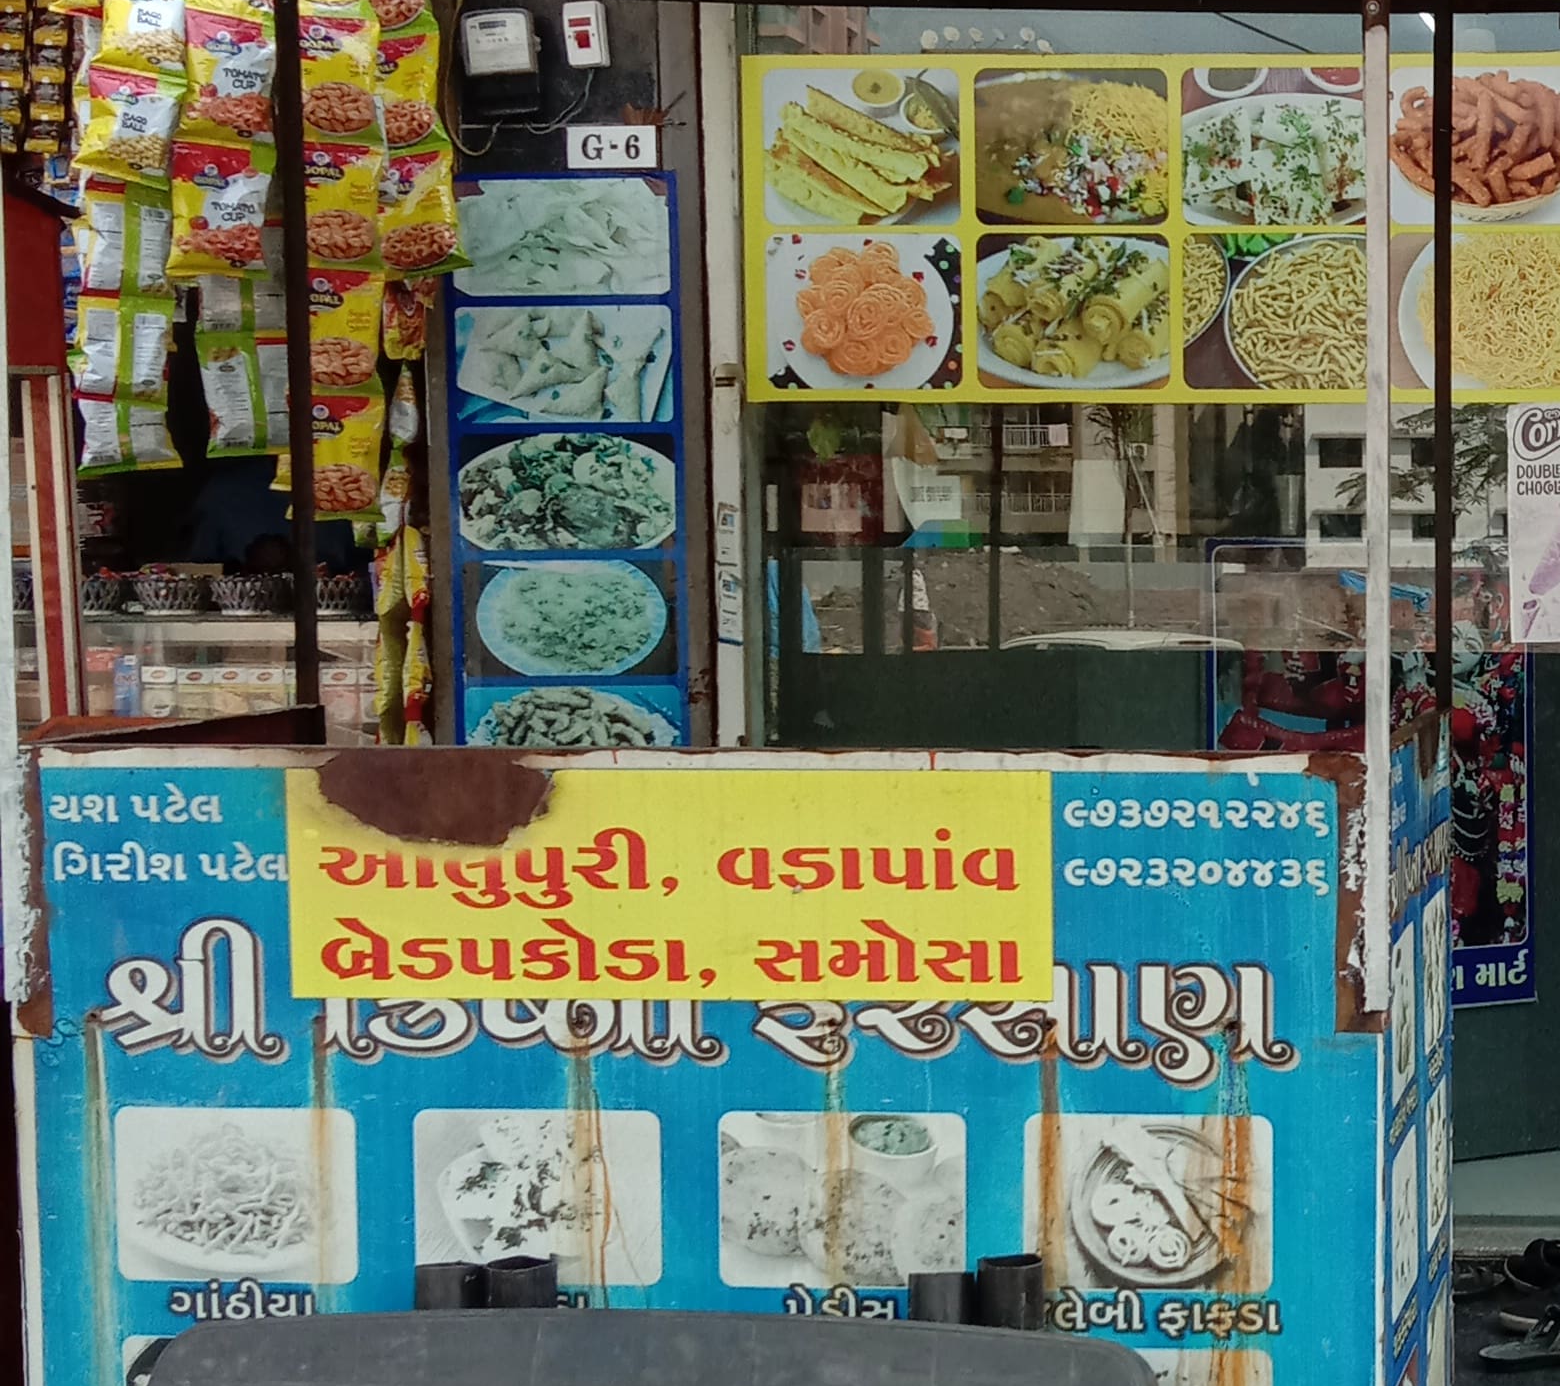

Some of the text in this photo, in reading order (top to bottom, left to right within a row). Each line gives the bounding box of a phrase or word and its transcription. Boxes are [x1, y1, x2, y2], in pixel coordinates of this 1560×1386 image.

[309, 293, 341, 304] OPAL
[312, 420, 342, 432] OPAL
[1516, 464, 1560, 479] DOUBLE
[49, 782, 223, 823] યશ પટેલ
[53, 840, 289, 882] ગિરીશ પટેલ
[716, 828, 1020, 892] વડાપાંવ
[754, 918, 1023, 984] સમોસા
[1476, 949, 1529, 988] માર્ટ
[100, 917, 286, 1062] શ્રી
[1044, 1286, 1142, 1334] લેબી
